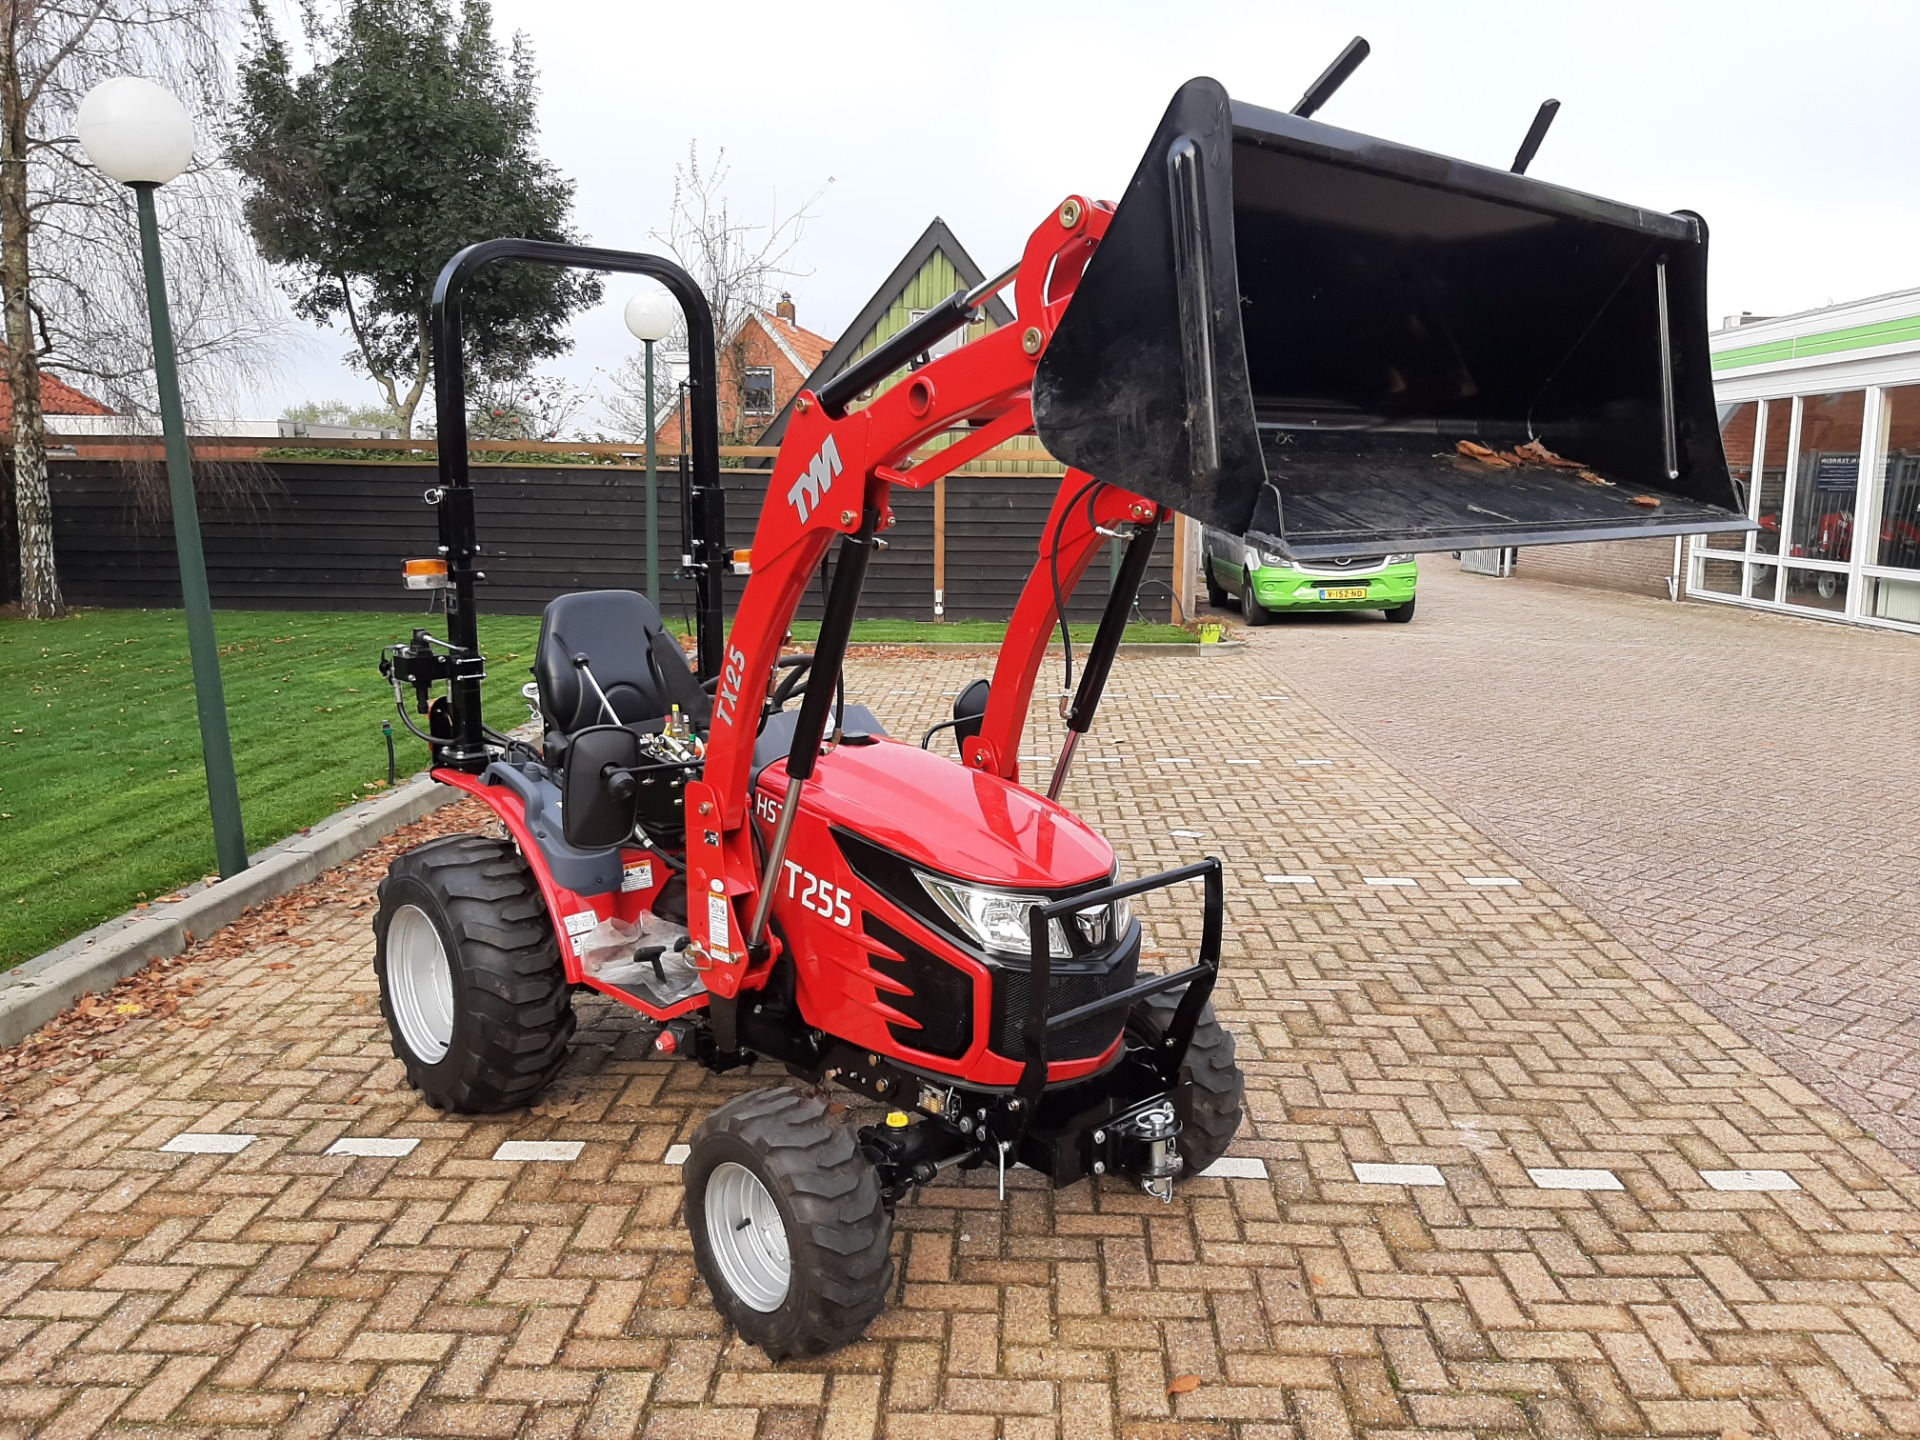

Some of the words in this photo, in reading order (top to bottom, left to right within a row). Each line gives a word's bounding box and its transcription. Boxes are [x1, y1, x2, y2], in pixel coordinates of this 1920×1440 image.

[787, 432, 843, 525] TYM
[1327, 590, 1363, 598] V-152-ND
[716, 645, 746, 727] TX25
[784, 860, 851, 927] T255
